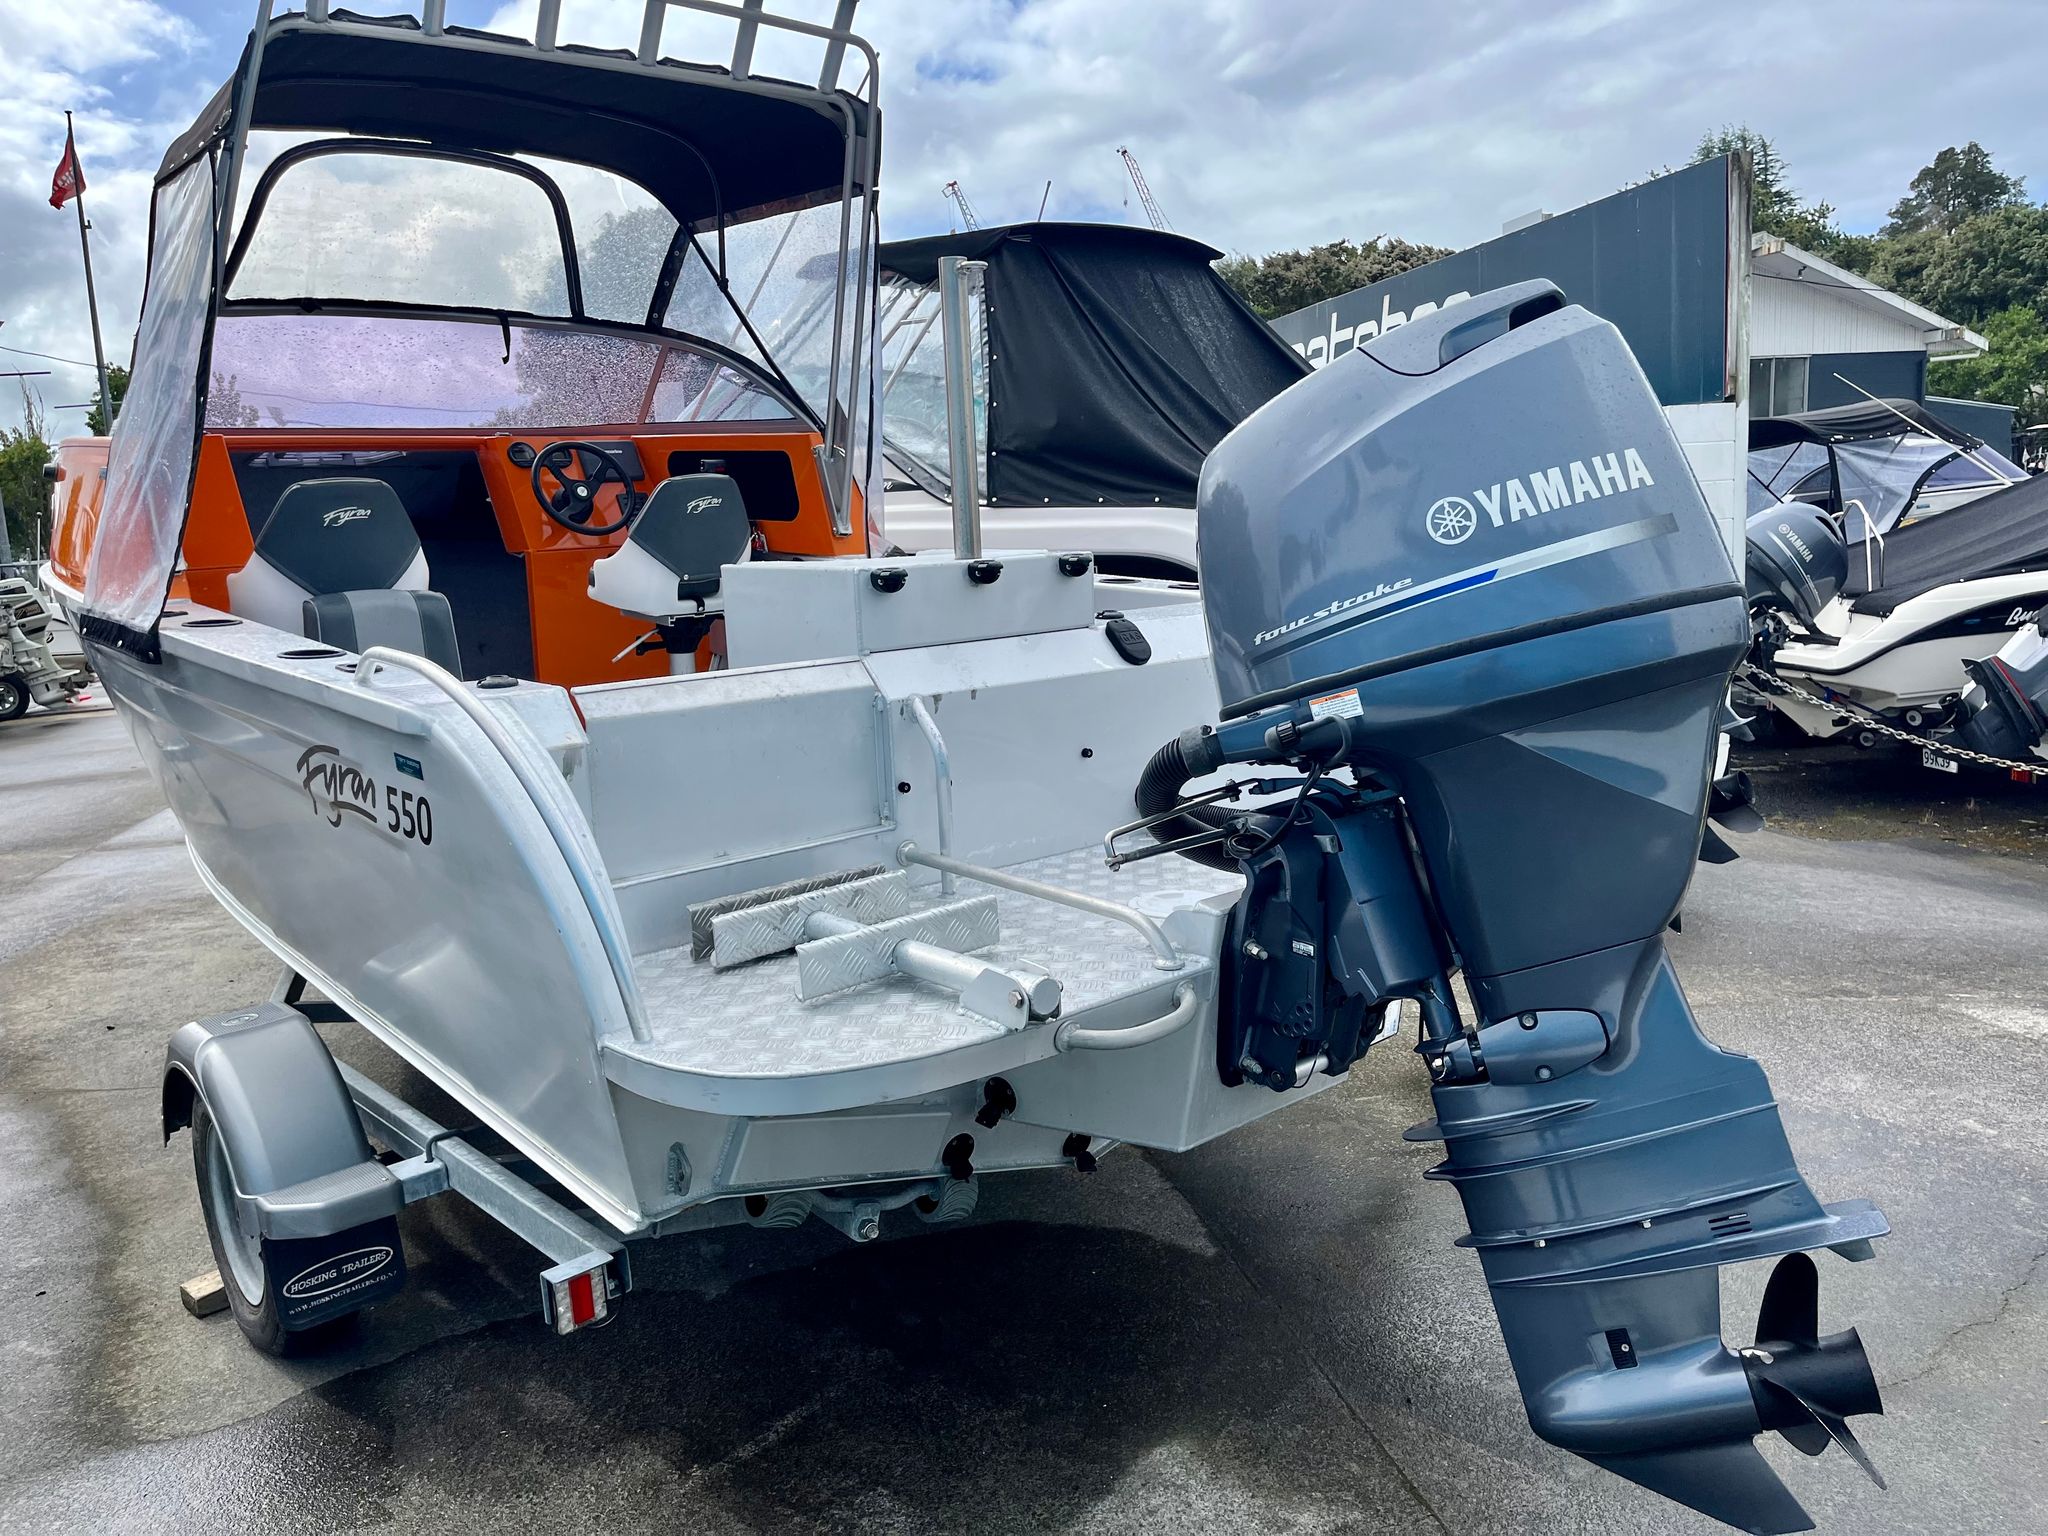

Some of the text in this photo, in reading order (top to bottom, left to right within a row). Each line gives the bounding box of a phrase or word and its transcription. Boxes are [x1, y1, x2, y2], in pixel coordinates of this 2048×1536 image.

[1472, 447, 1655, 528] YAMAHA
[323, 506, 371, 527] Fyran
[687, 495, 722, 514] Fyran
[1786, 530, 1814, 563] YAMAHA
[1121, 631, 1142, 642] GAS
[296, 744, 433, 846] Fyran 550
[290, 1251, 387, 1294] HOSKING TRAILERS
